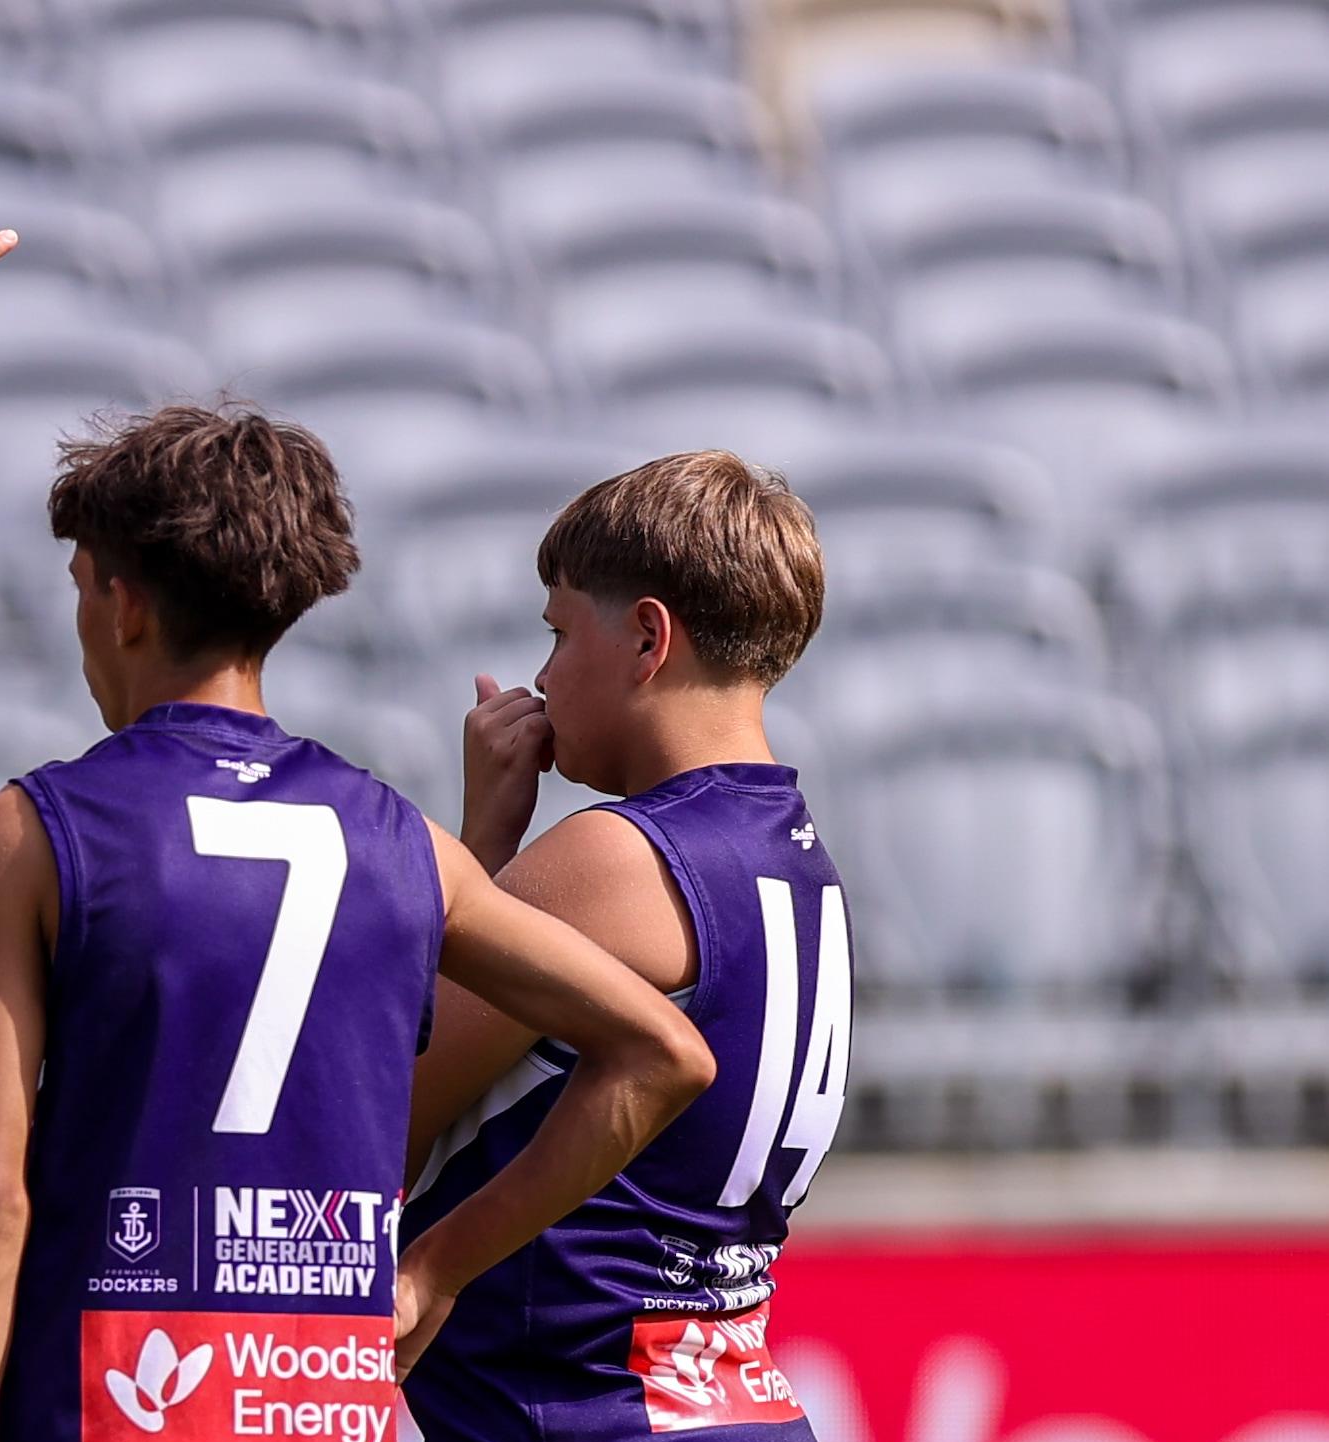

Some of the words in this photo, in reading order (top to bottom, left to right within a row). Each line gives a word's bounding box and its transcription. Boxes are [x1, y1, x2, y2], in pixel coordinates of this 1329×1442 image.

[184, 795, 349, 1135] 7
[717, 876, 852, 1207] 14
[214, 1186, 383, 1241] NEXT
[215, 1238, 376, 1267] GENERATION
[88, 1277, 179, 1292] DOCKERS
[214, 1263, 376, 1297] ACADEMY
[224, 1332, 397, 1383] Woodsi
